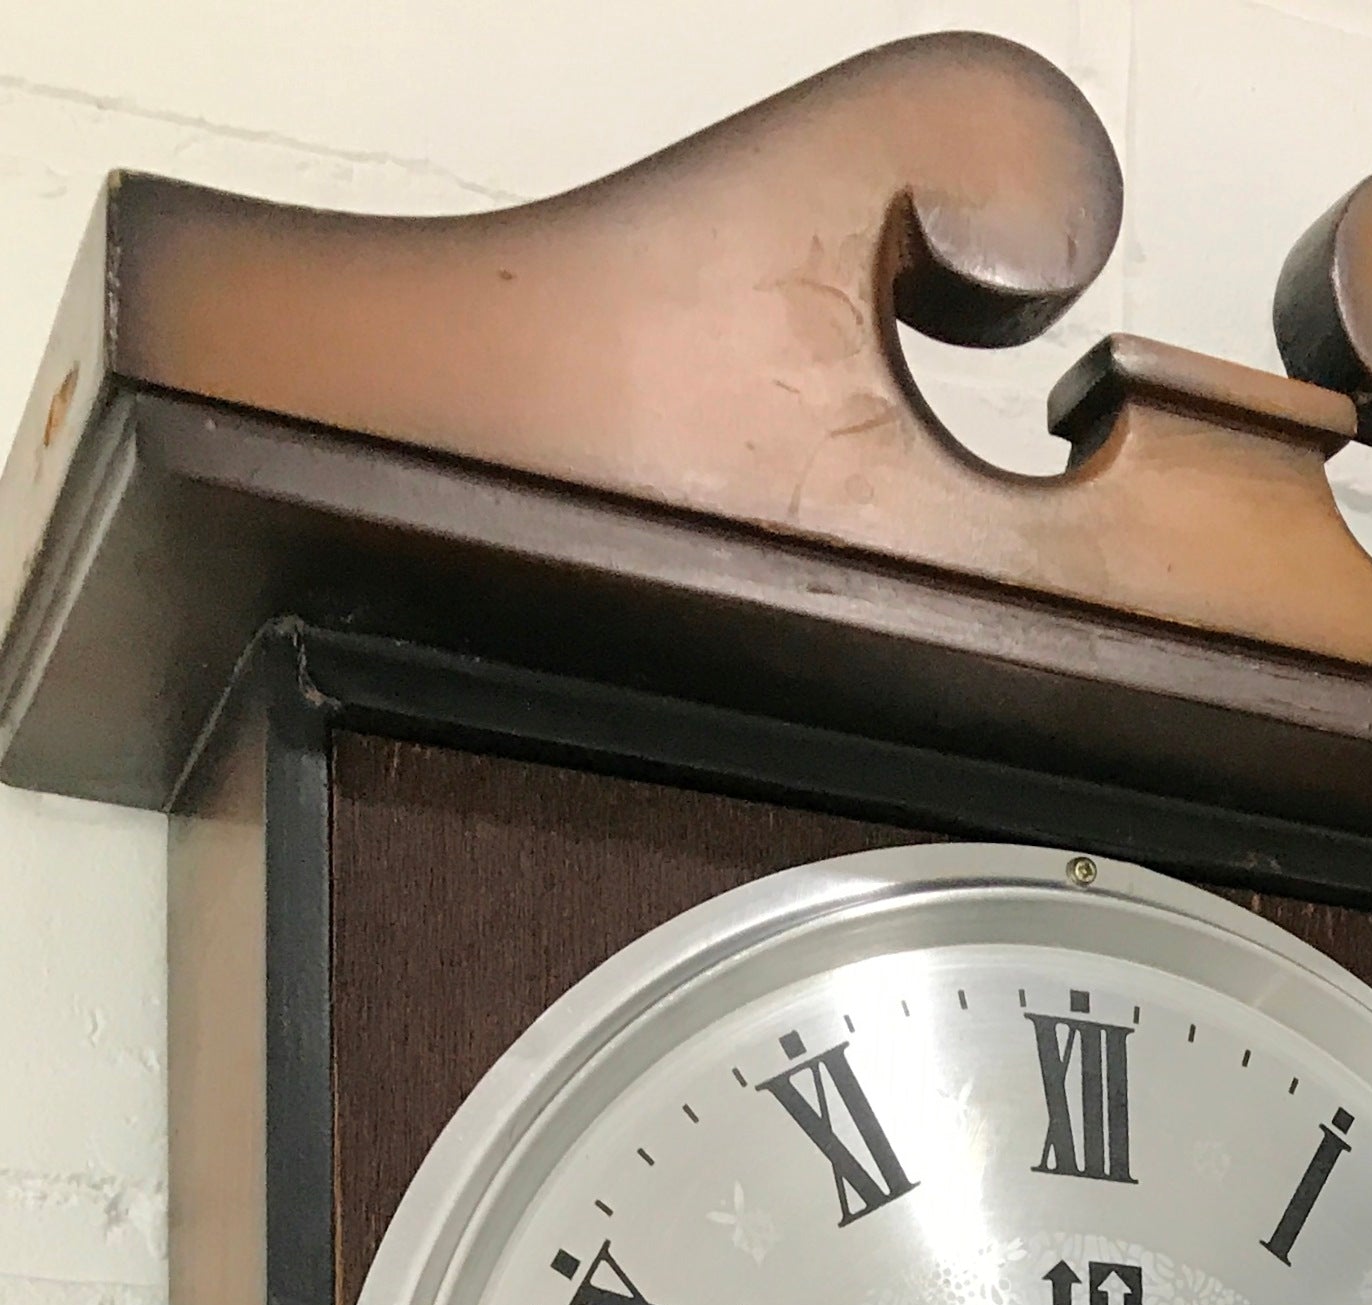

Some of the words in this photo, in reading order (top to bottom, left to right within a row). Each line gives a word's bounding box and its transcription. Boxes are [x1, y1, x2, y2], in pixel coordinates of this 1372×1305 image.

[755, 1041, 921, 1228] XI
[1024, 1012, 1139, 1184] XII
[1259, 1123, 1351, 1266] I
